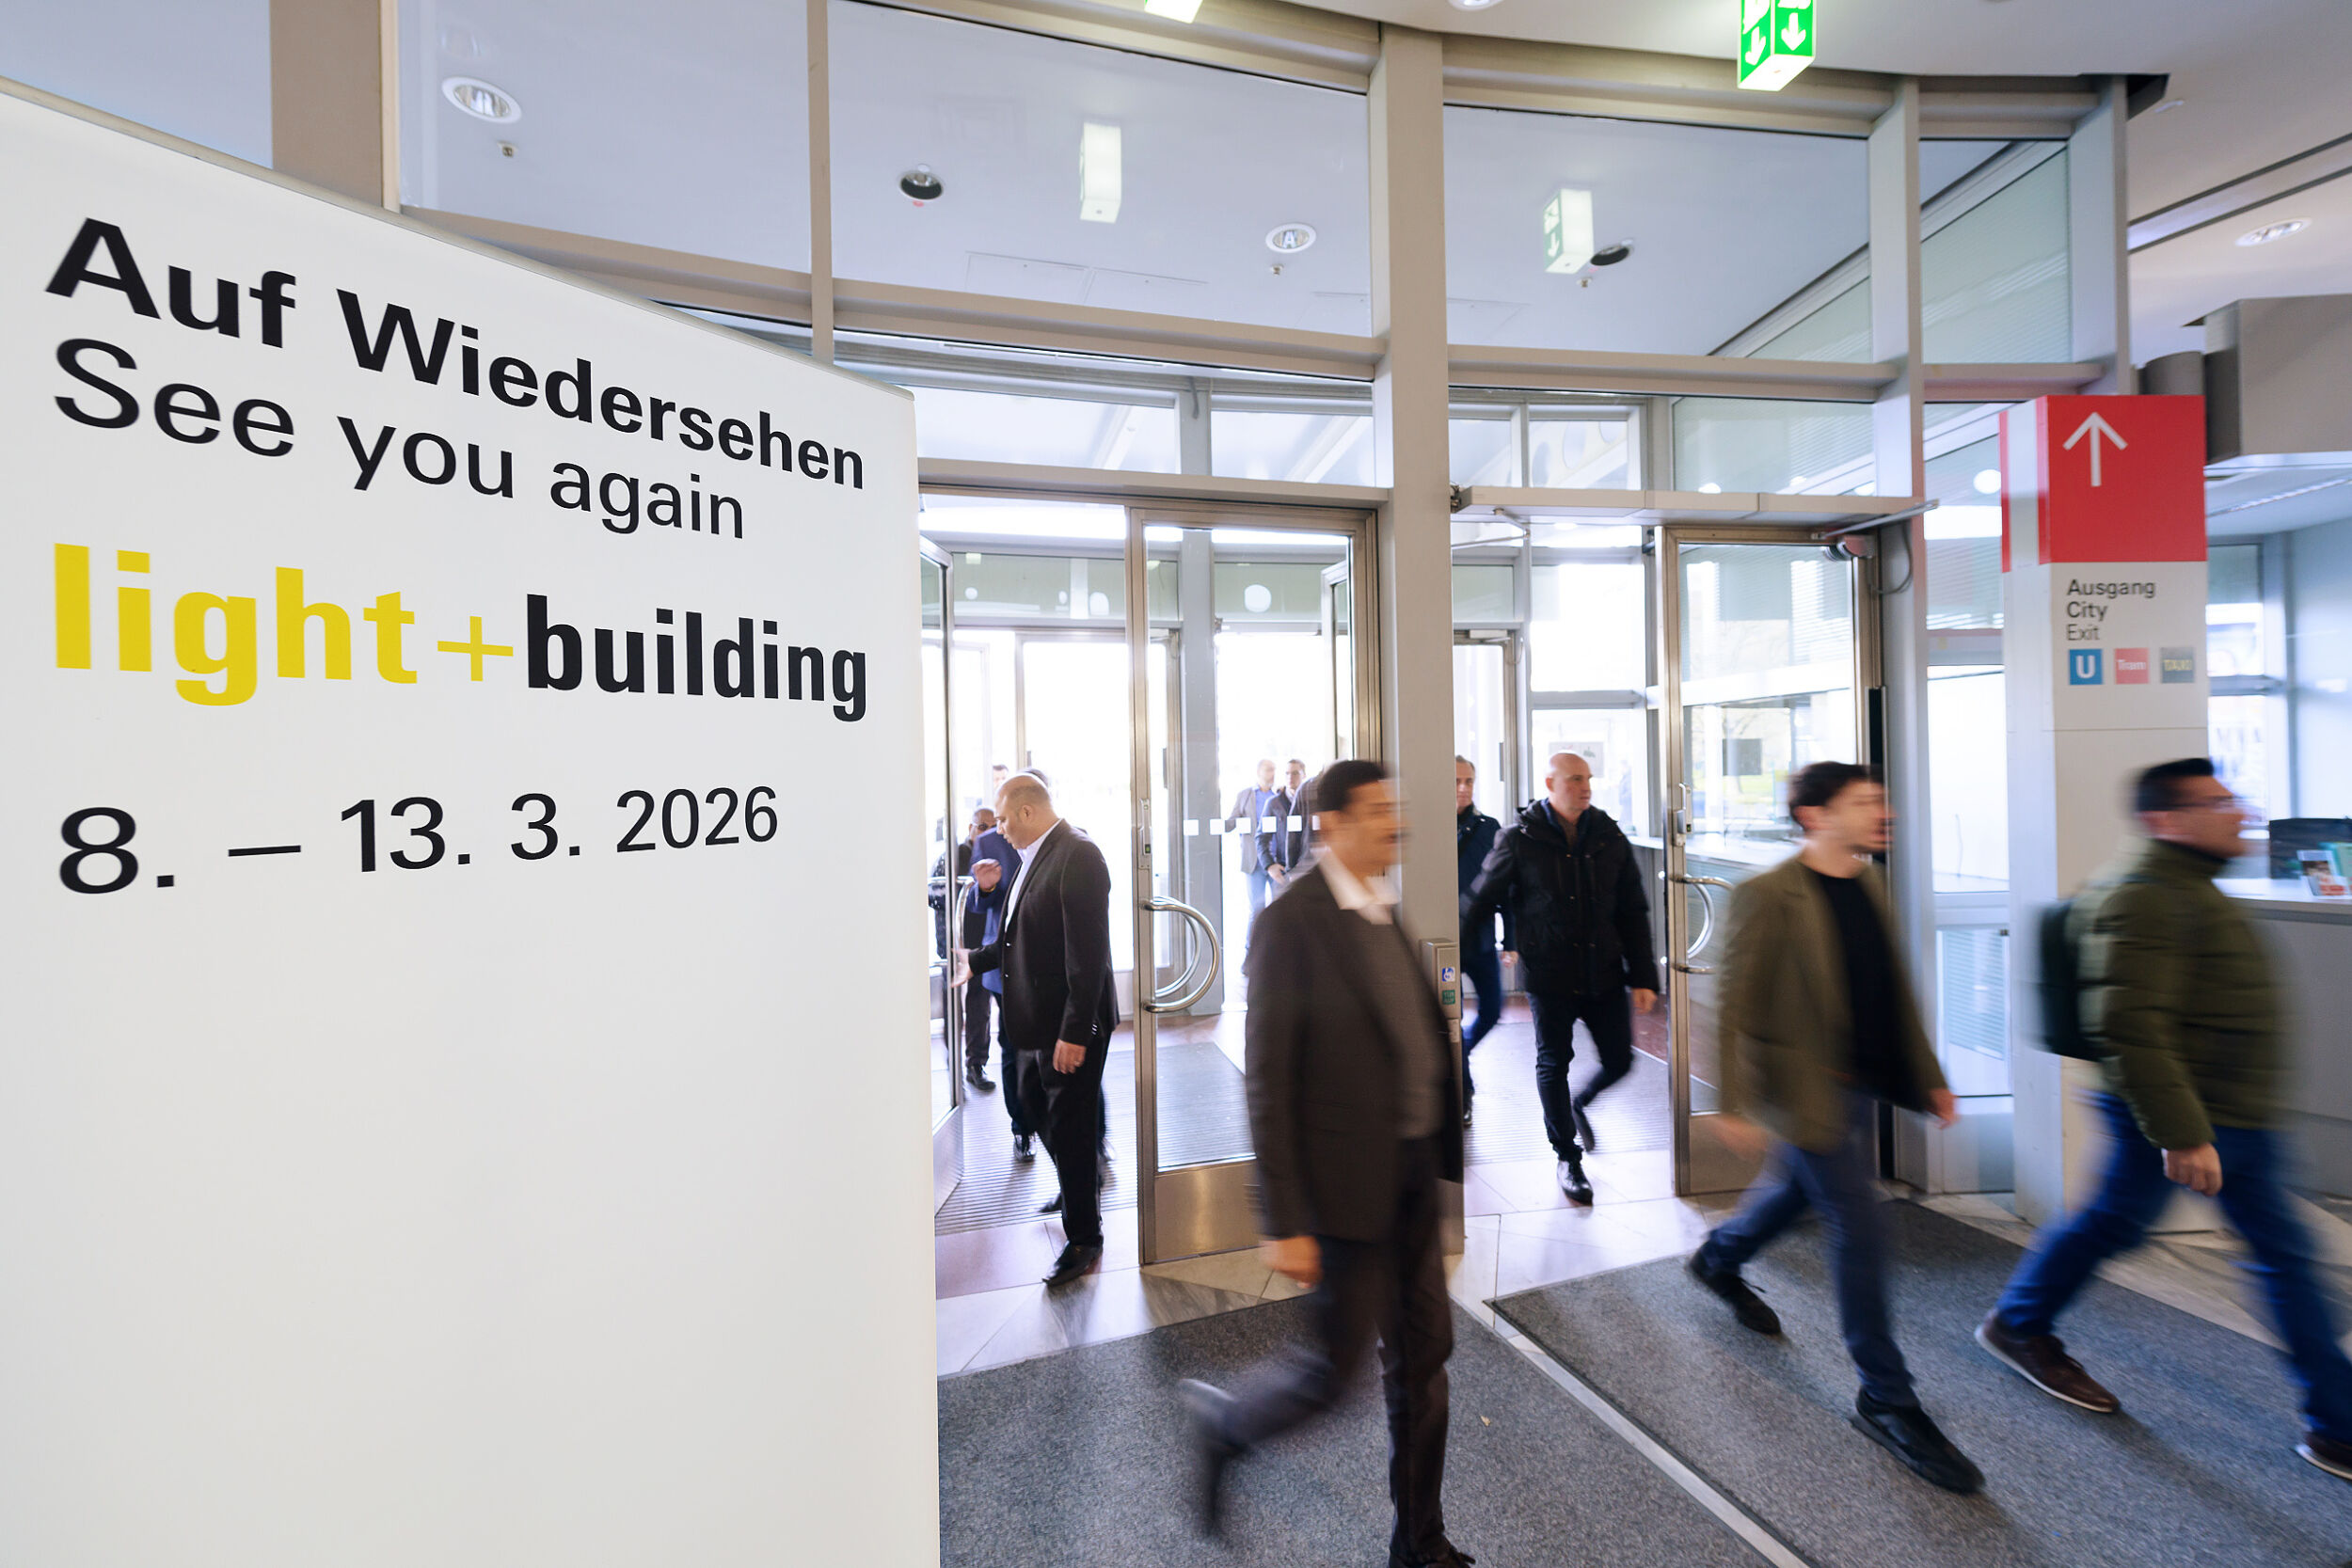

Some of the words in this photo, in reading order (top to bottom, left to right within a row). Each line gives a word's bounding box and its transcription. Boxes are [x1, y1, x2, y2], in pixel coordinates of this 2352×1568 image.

[44, 217, 296, 349] Auf
[336, 288, 864, 490] Wiedersehen
[54, 338, 295, 457] See
[336, 414, 514, 499] you
[549, 461, 744, 540] again
[2067, 578, 2155, 599] Ausgang
[2066, 601, 2108, 622] City
[2067, 624, 2100, 641] Exit
[2076, 655, 2096, 678] U
[2117, 659, 2146, 671] Tram
[58, 806, 176, 895] 8.
[341, 796, 471, 873] 13.
[509, 792, 580, 861] 3.
[615, 785, 779, 853] 2026
